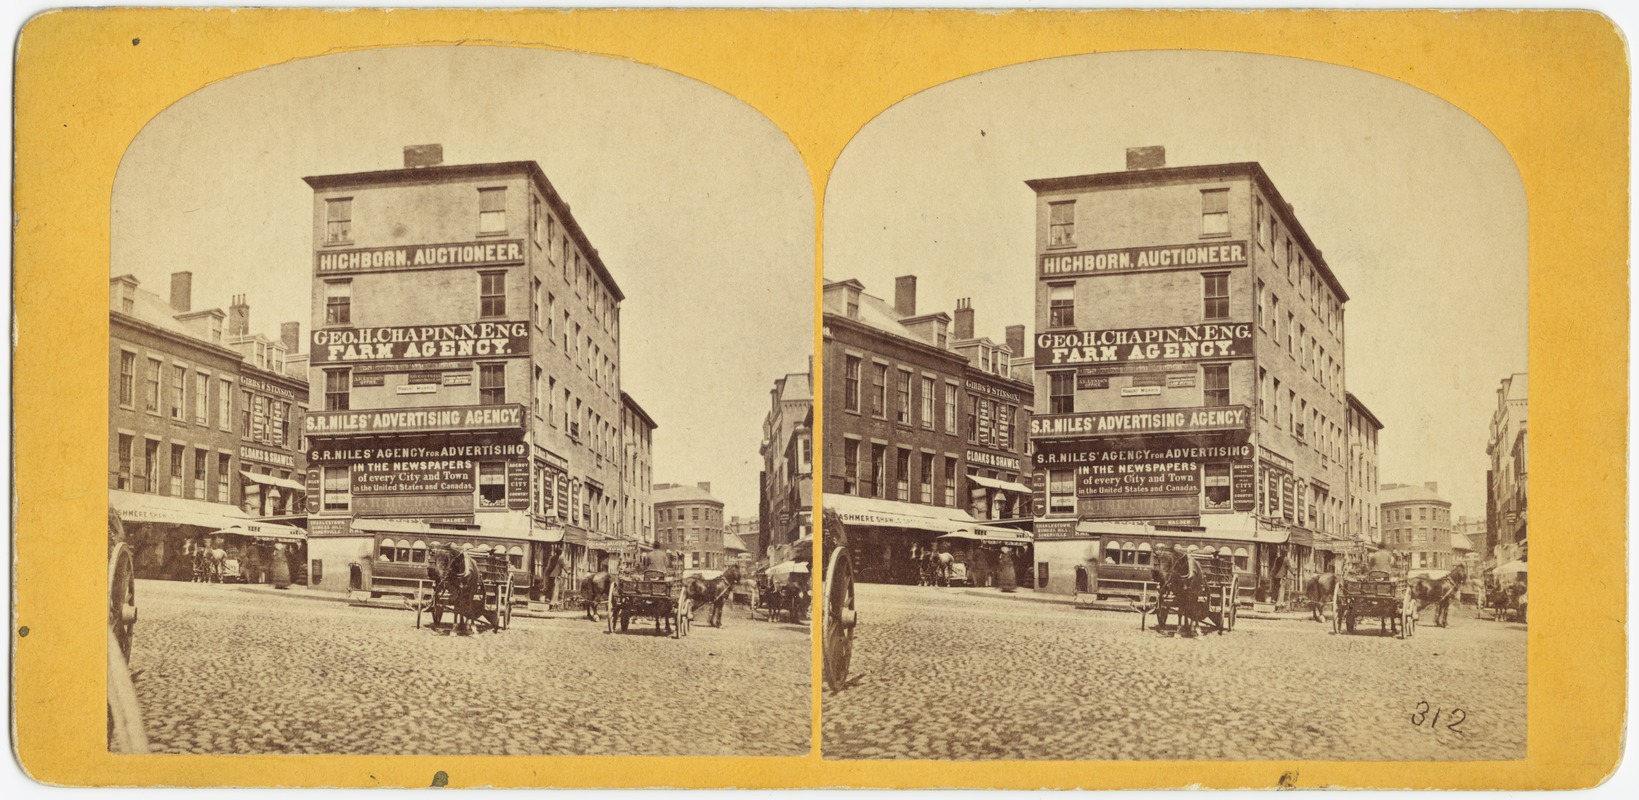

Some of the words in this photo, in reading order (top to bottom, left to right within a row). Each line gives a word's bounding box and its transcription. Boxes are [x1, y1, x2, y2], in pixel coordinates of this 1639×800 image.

[320, 250, 411, 271] HICHBORN,
[414, 243, 523, 265] AUCTIONEER.
[1044, 253, 1134, 273] HICHBORN,
[1137, 245, 1246, 267] AUCTIONEER.
[327, 343, 393, 361] FARM
[403, 338, 512, 358] AGENCY.
[1052, 346, 1118, 364] FARM
[1128, 340, 1235, 360] AGENCY.
[241, 376, 261, 387] GIBBS
[966, 379, 986, 392] GIBBS
[373, 410, 460, 428] ADVERTISING
[464, 408, 519, 425] AGENCY.
[1098, 412, 1185, 430] ADVERTISING
[1189, 410, 1244, 427] AGENCY.
[240, 446, 264, 461] CLOAKS
[264, 451, 270, 462] &
[377, 447, 425, 459] AGENCY
[440, 444, 525, 457] ADVERTISING
[966, 450, 990, 465] CLOAKS
[990, 454, 996, 465] &
[1102, 449, 1150, 461] AGENCY
[1165, 445, 1250, 459] ADVERTISING
[353, 463, 364, 472] IN
[367, 462, 389, 472] THE
[393, 460, 472, 471] NEWSPAPERS
[1079, 466, 1090, 475] IN
[1093, 465, 1114, 474] THE
[1118, 462, 1197, 473] NEWSPAPERS
[358, 473, 368, 482] of
[369, 474, 396, 484] every
[398, 472, 420, 484] City
[423, 471, 440, 481] and
[443, 471, 469, 480] Town
[1083, 476, 1093, 485] of
[1094, 477, 1121, 487] every
[1124, 474, 1145, 486] City
[1148, 474, 1165, 483] and
[1168, 473, 1194, 482] Town
[373, 483, 397, 491] United
[399, 483, 424, 491] States
[425, 482, 438, 490] and
[440, 482, 474, 490] Canadas.
[1098, 486, 1122, 494] United
[1124, 485, 1149, 493] States
[1150, 484, 1163, 492] and
[1165, 484, 1199, 492] Canadas.
[1411, 700, 1466, 733] 312
